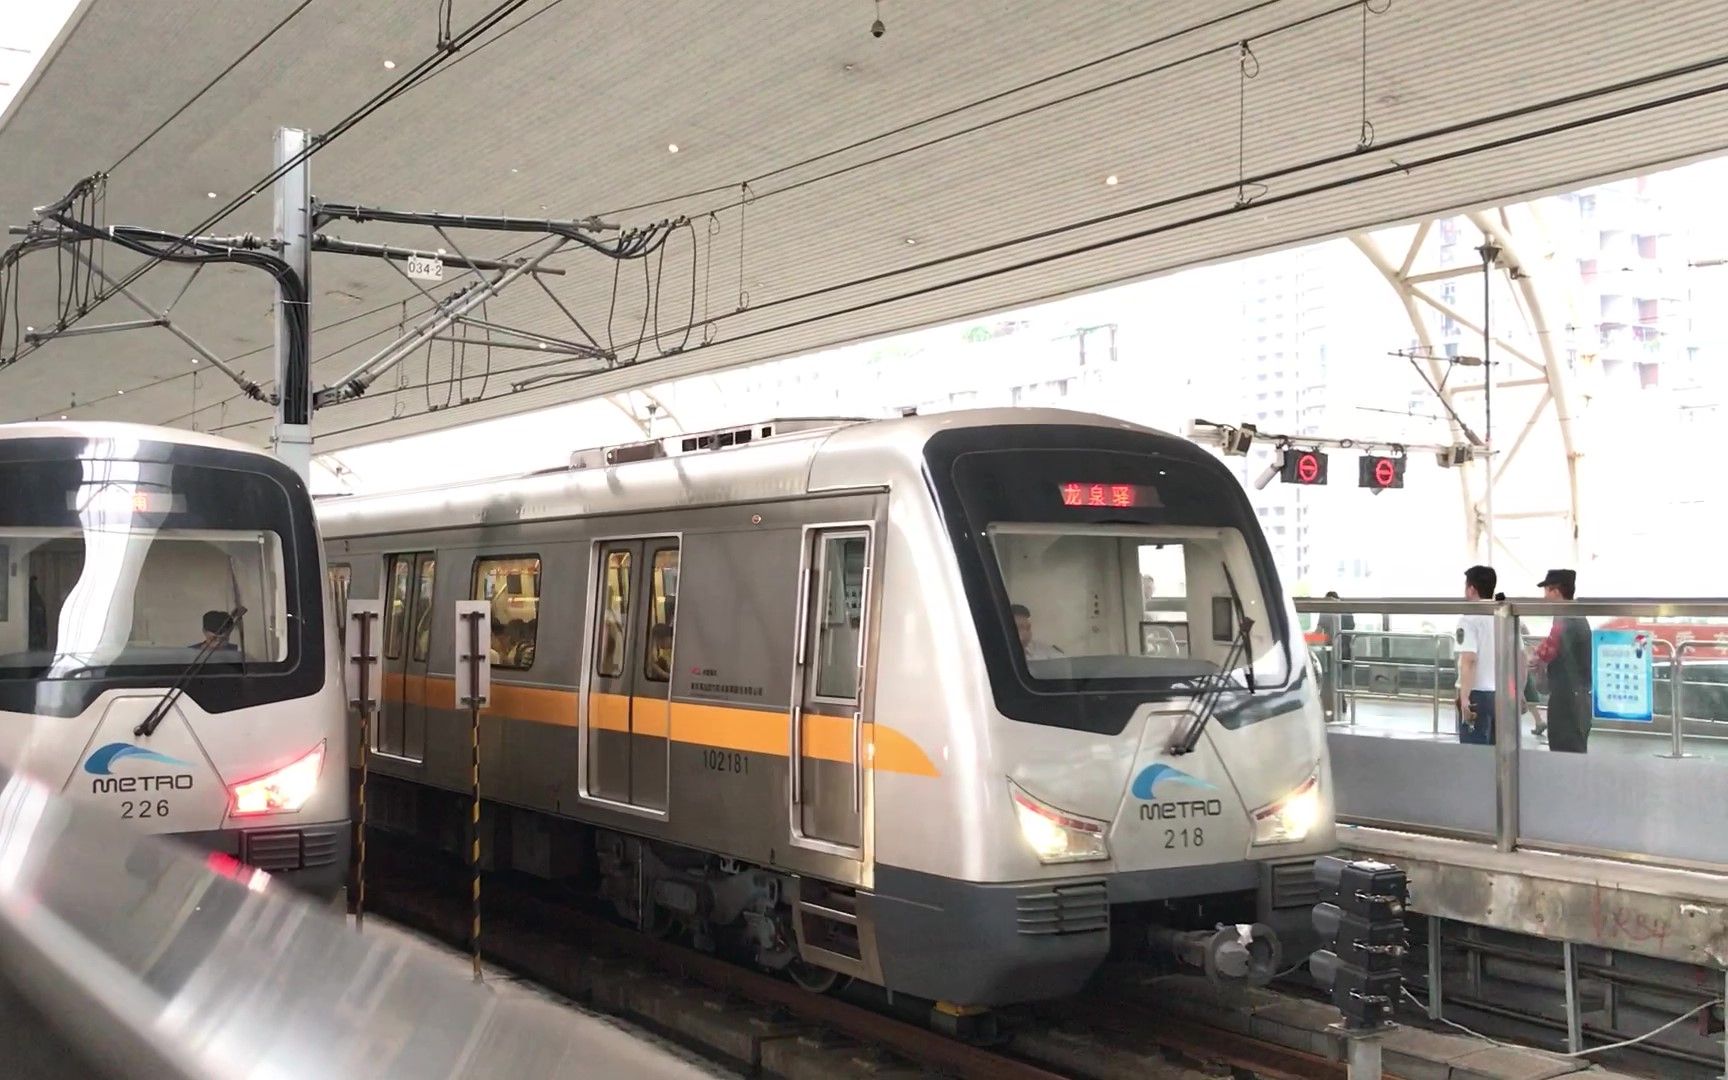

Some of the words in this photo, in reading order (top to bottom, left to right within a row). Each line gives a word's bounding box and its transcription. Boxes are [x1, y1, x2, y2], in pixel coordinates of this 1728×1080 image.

[408, 261, 442, 276] 034-2
[1063, 483, 1130, 507] 龙泉驿
[703, 749, 748, 775] 102181
[120, 799, 169, 819] 226
[1163, 827, 1204, 849] 218
